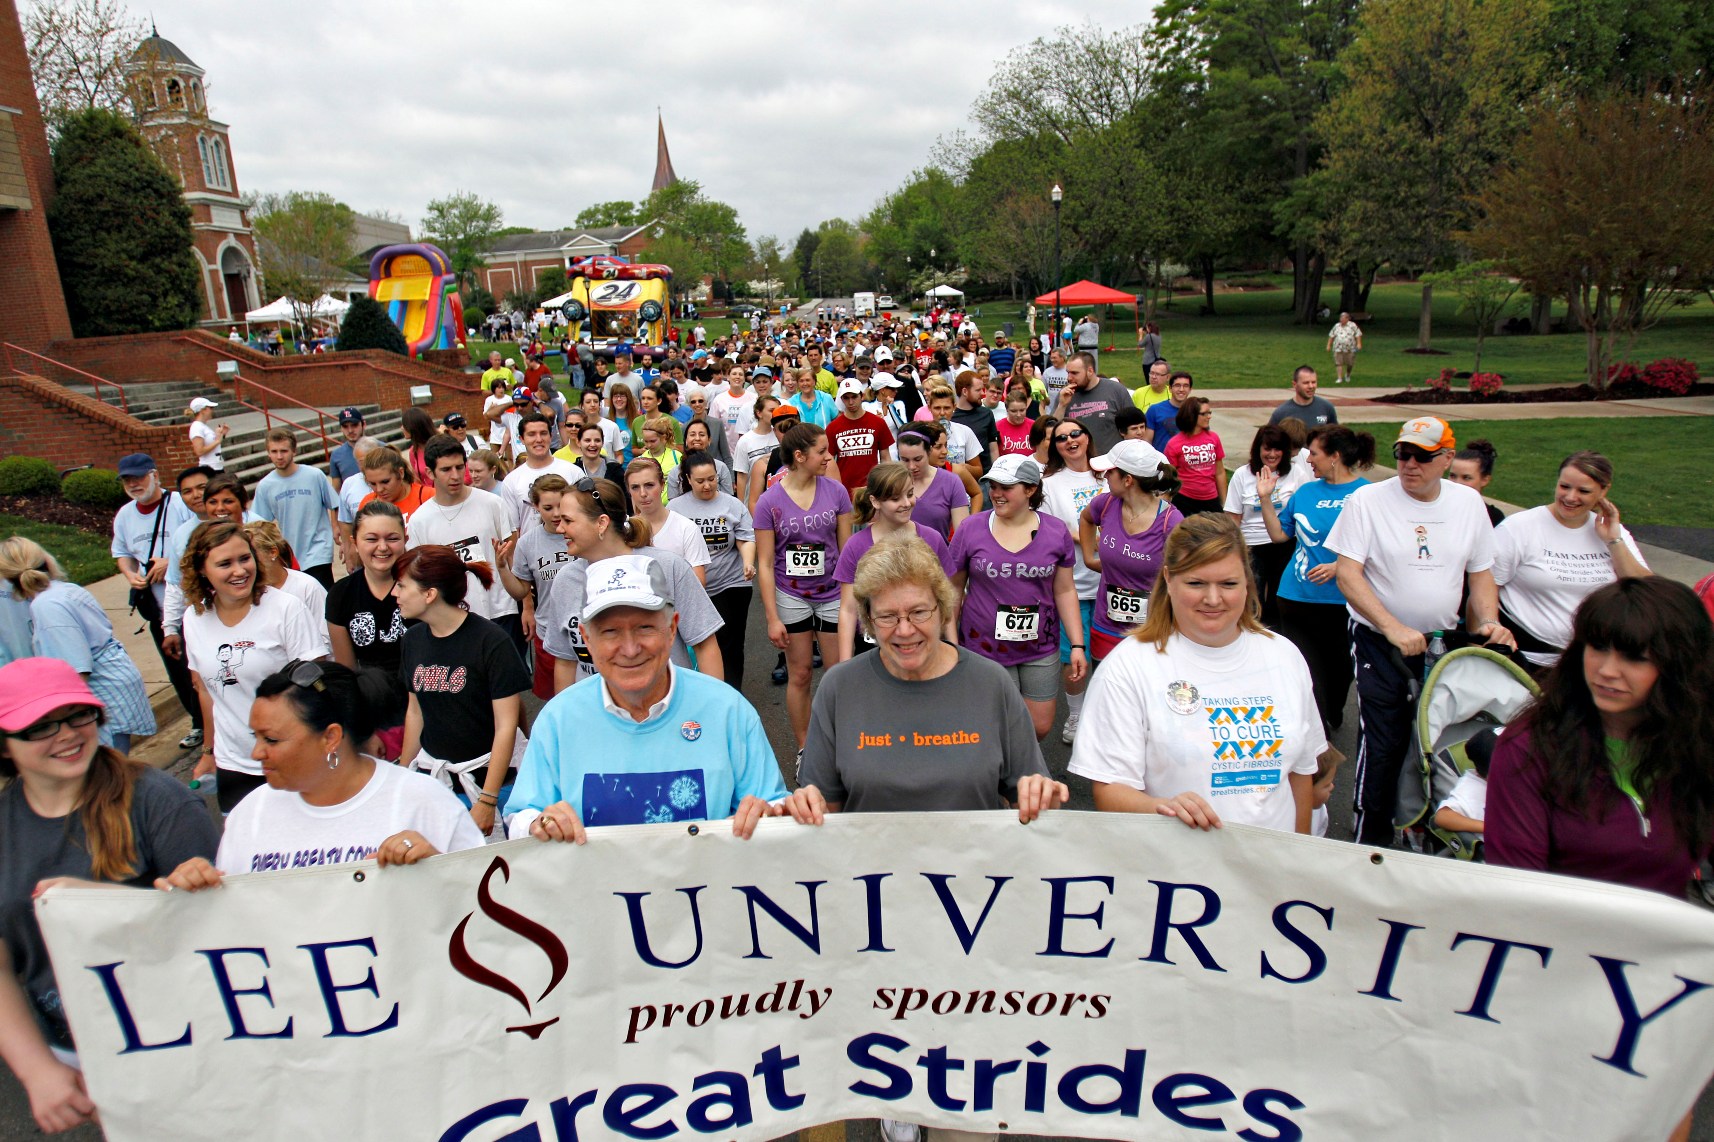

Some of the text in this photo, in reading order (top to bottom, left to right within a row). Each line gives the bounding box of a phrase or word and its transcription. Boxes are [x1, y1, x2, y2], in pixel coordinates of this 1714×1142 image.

[606, 269, 616, 278] 24
[597, 282, 637, 300] 24
[836, 428, 867, 438] PROPERTY
[841, 436, 870, 448] XXL
[1182, 443, 1214, 454] Dream
[690, 518, 716, 526] EAT
[700, 526, 729, 534] IDES
[780, 517, 800, 537] 65
[1103, 535, 1151, 561] 65 Roses
[1543, 549, 1610, 561] TEAM NATHAN
[793, 552, 819, 566] 678
[986, 562, 1012, 578] 65
[1556, 575, 1575, 583] April
[1110, 594, 1141, 613] 665
[1005, 614, 1034, 630] 677
[413, 664, 467, 693] OWLS
[1202, 696, 1274, 706] TAKING STEPS
[857, 730, 980, 750] just breathe
[1209, 724, 1284, 741] TO CURE
[1211, 759, 1283, 771] CYSTIC FIBROSIS
[85, 872, 1713, 1077] LEE UNIVERSITY
[624, 980, 1111, 1044] proudly sponsors
[438, 1033, 1304, 1142] Great Strides
